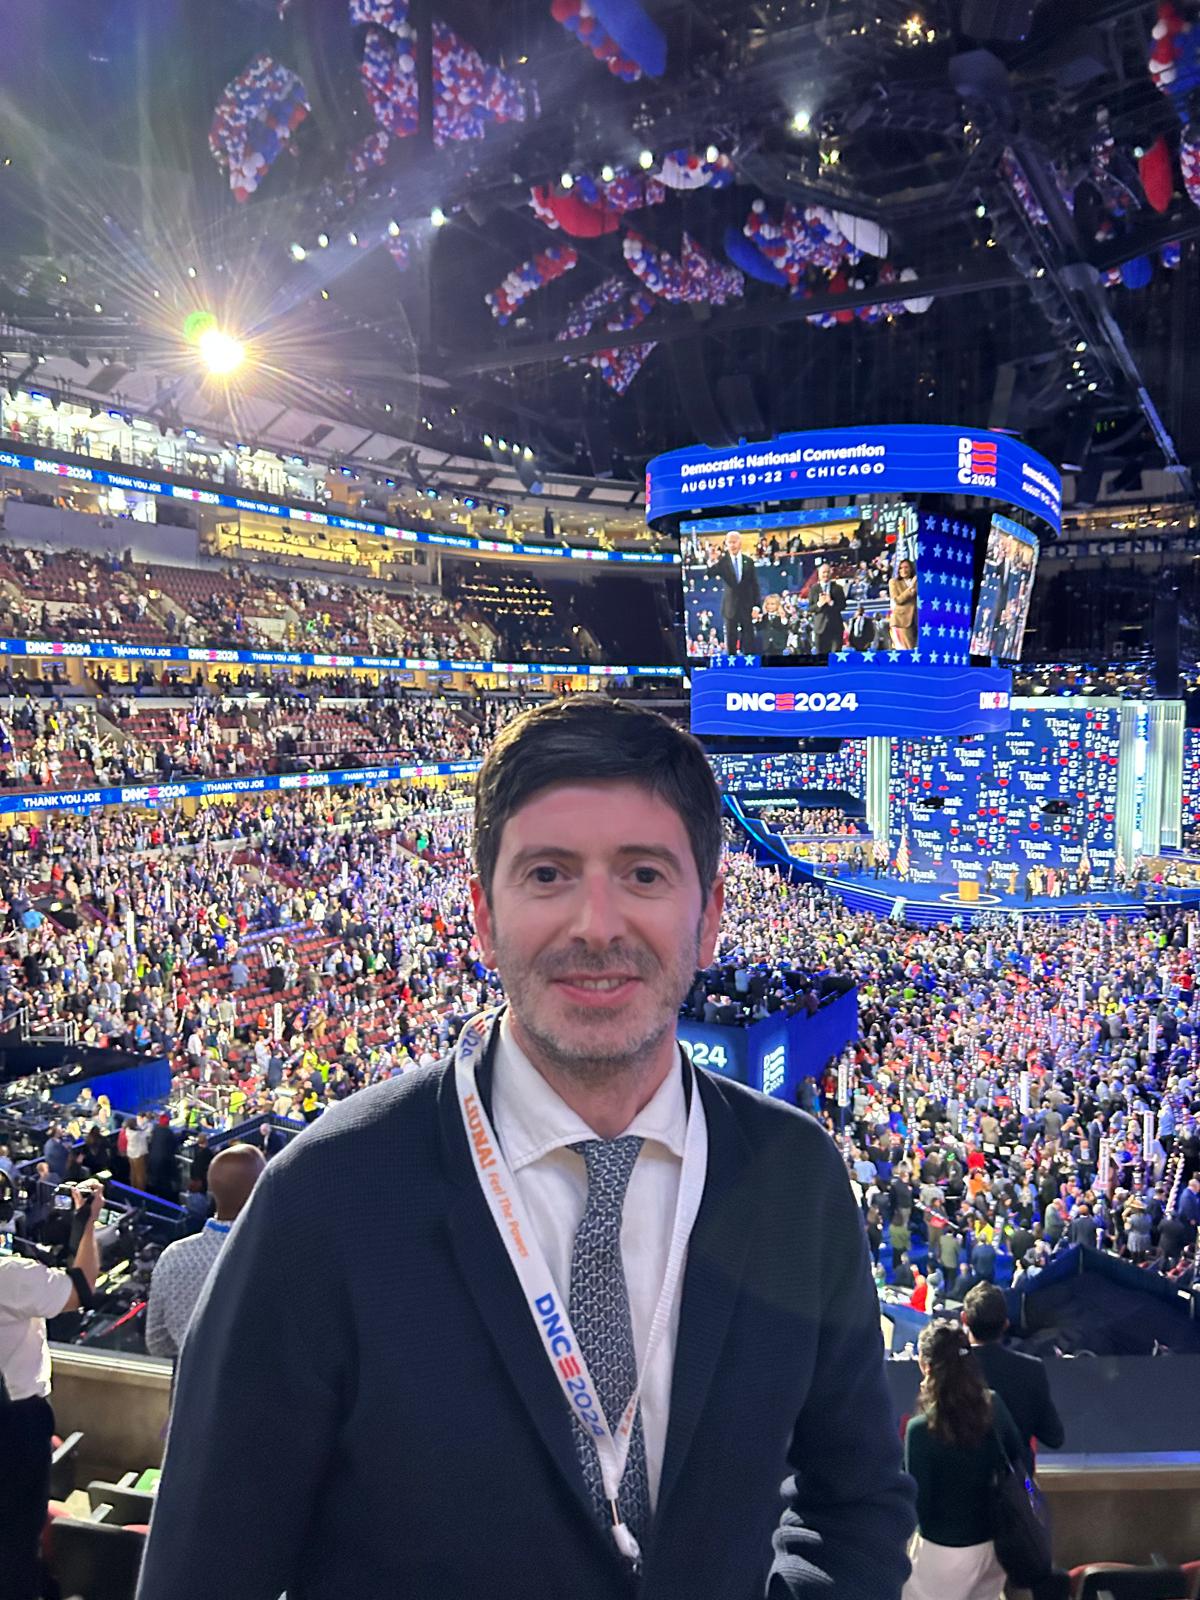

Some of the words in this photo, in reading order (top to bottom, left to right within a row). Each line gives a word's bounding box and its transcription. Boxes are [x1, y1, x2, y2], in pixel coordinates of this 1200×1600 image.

[681, 456, 744, 477] Democratic
[747, 449, 800, 467] National
[803, 444, 885, 463] Convention
[958, 437, 973, 484] DNC
[108, 475, 133, 487] THANK
[133, 480, 148, 489] YOU
[681, 476, 735, 494] AUGUST
[741, 470, 782, 486] 19-22
[806, 463, 885, 479] CHICAGO
[971, 473, 997, 487] 2024
[26, 641, 53, 655] DNC
[62, 644, 92, 656] 2024
[112, 646, 139, 656] THANK
[140, 647, 156, 656] YOU
[156, 648, 172, 657] JOE
[252, 653, 274, 661] THANK
[273, 654, 287, 662] YOU
[726, 692, 776, 711] DNC
[794, 692, 858, 711] 2024
[1069, 723, 1081, 740] WE
[1084, 721, 1093, 748] JOE
[953, 747, 987, 758] Thank
[1010, 746, 1029, 756] You
[1108, 740, 1120, 757] WE
[912, 759, 921, 776] WE
[959, 757, 980, 767] You
[998, 761, 1010, 778] WE
[1069, 751, 1079, 777] JOE
[344, 772, 365, 781] THANK
[365, 771, 377, 780] YOU
[377, 770, 389, 779] JOE
[922, 764, 934, 781] WE
[945, 772, 965, 781] You
[1018, 770, 1051, 781] Thank
[1058, 767, 1069, 793] JOE
[1107, 767, 1117, 793] JOE
[121, 787, 149, 802] DNC
[157, 784, 187, 799] 2024
[207, 782, 233, 792] THANK
[233, 780, 250, 791] YOU
[249, 779, 265, 790] JOE
[1024, 780, 1045, 790] You
[23, 795, 60, 808] THANK
[60, 794, 80, 806] YOU
[80, 792, 101, 804] JOE
[988, 789, 999, 808] WE
[999, 788, 1008, 814] JOE
[1103, 796, 1116, 812] WE
[912, 811, 930, 822] You
[1076, 801, 1084, 825] JOE
[912, 829, 941, 840] Thank
[976, 821, 988, 838] WE
[989, 818, 998, 843] JOE
[932, 844, 944, 860] WE
[1018, 839, 1052, 851] Thank
[1025, 849, 1046, 860] You
[1061, 853, 1079, 863] You
[1088, 848, 1117, 859] Thank
[910, 868, 937, 879] Thank
[950, 860, 983, 871] Thank
[957, 869, 977, 879] You
[679, 1040, 728, 1068] 024
[488, 1171, 507, 1196] Feel
[534, 1292, 572, 1357] DNC
[566, 1378, 605, 1437] 2024
